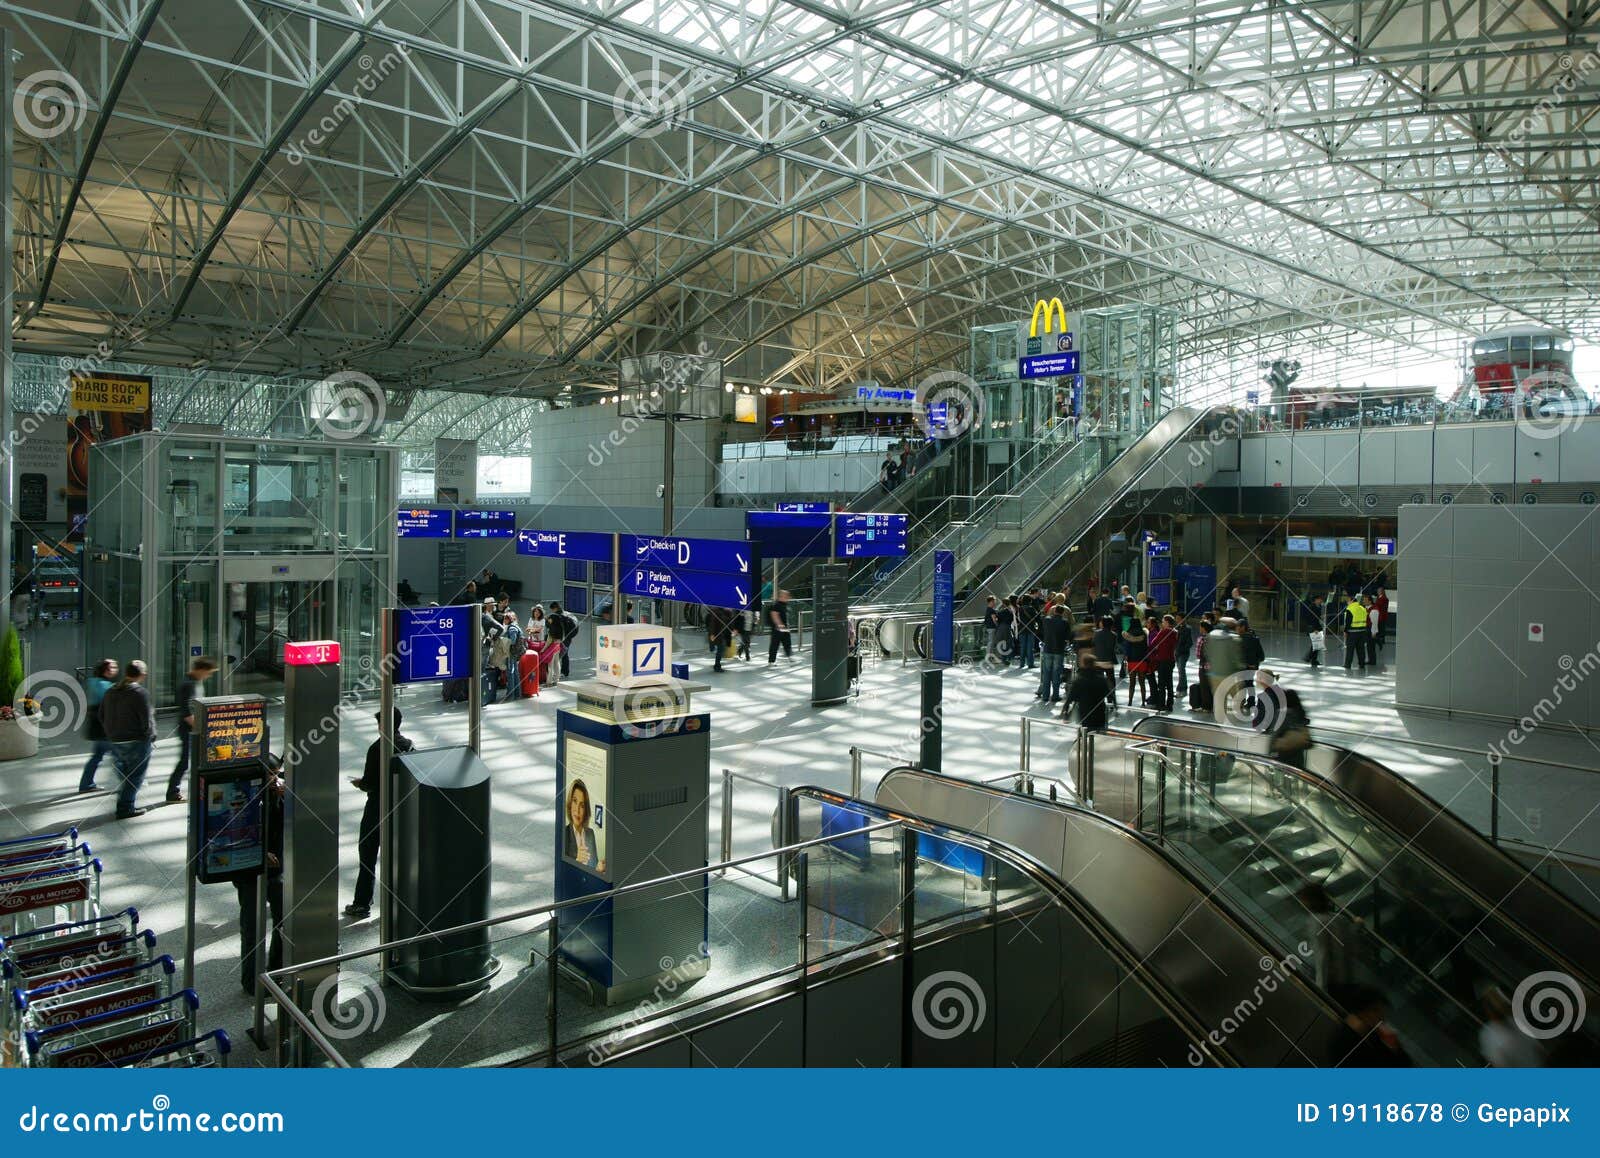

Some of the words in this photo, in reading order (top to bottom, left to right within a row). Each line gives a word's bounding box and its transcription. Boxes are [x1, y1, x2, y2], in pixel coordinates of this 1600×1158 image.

[75, 380, 109, 393] HARD
[112, 383, 142, 395] ROCK
[75, 391, 109, 404] RUNS
[875, 388, 903, 400] Away
[538, 533, 558, 543] Check-in
[558, 534, 566, 554] E
[649, 539, 676, 550] Check-in
[678, 541, 690, 564] D
[636, 571, 643, 586] P
[649, 571, 671, 583] Parken
[649, 584, 660, 594] Car
[661, 585, 676, 596] Park
[439, 618, 453, 629] 58
[208, 709, 262, 719] INTERNATIONAL
[207, 719, 236, 728] PHONE
[208, 729, 233, 738] SOLD
[235, 726, 259, 735] HERE
[47, 886, 81, 898] MOTORS
[85, 1005, 105, 1017] KIA
